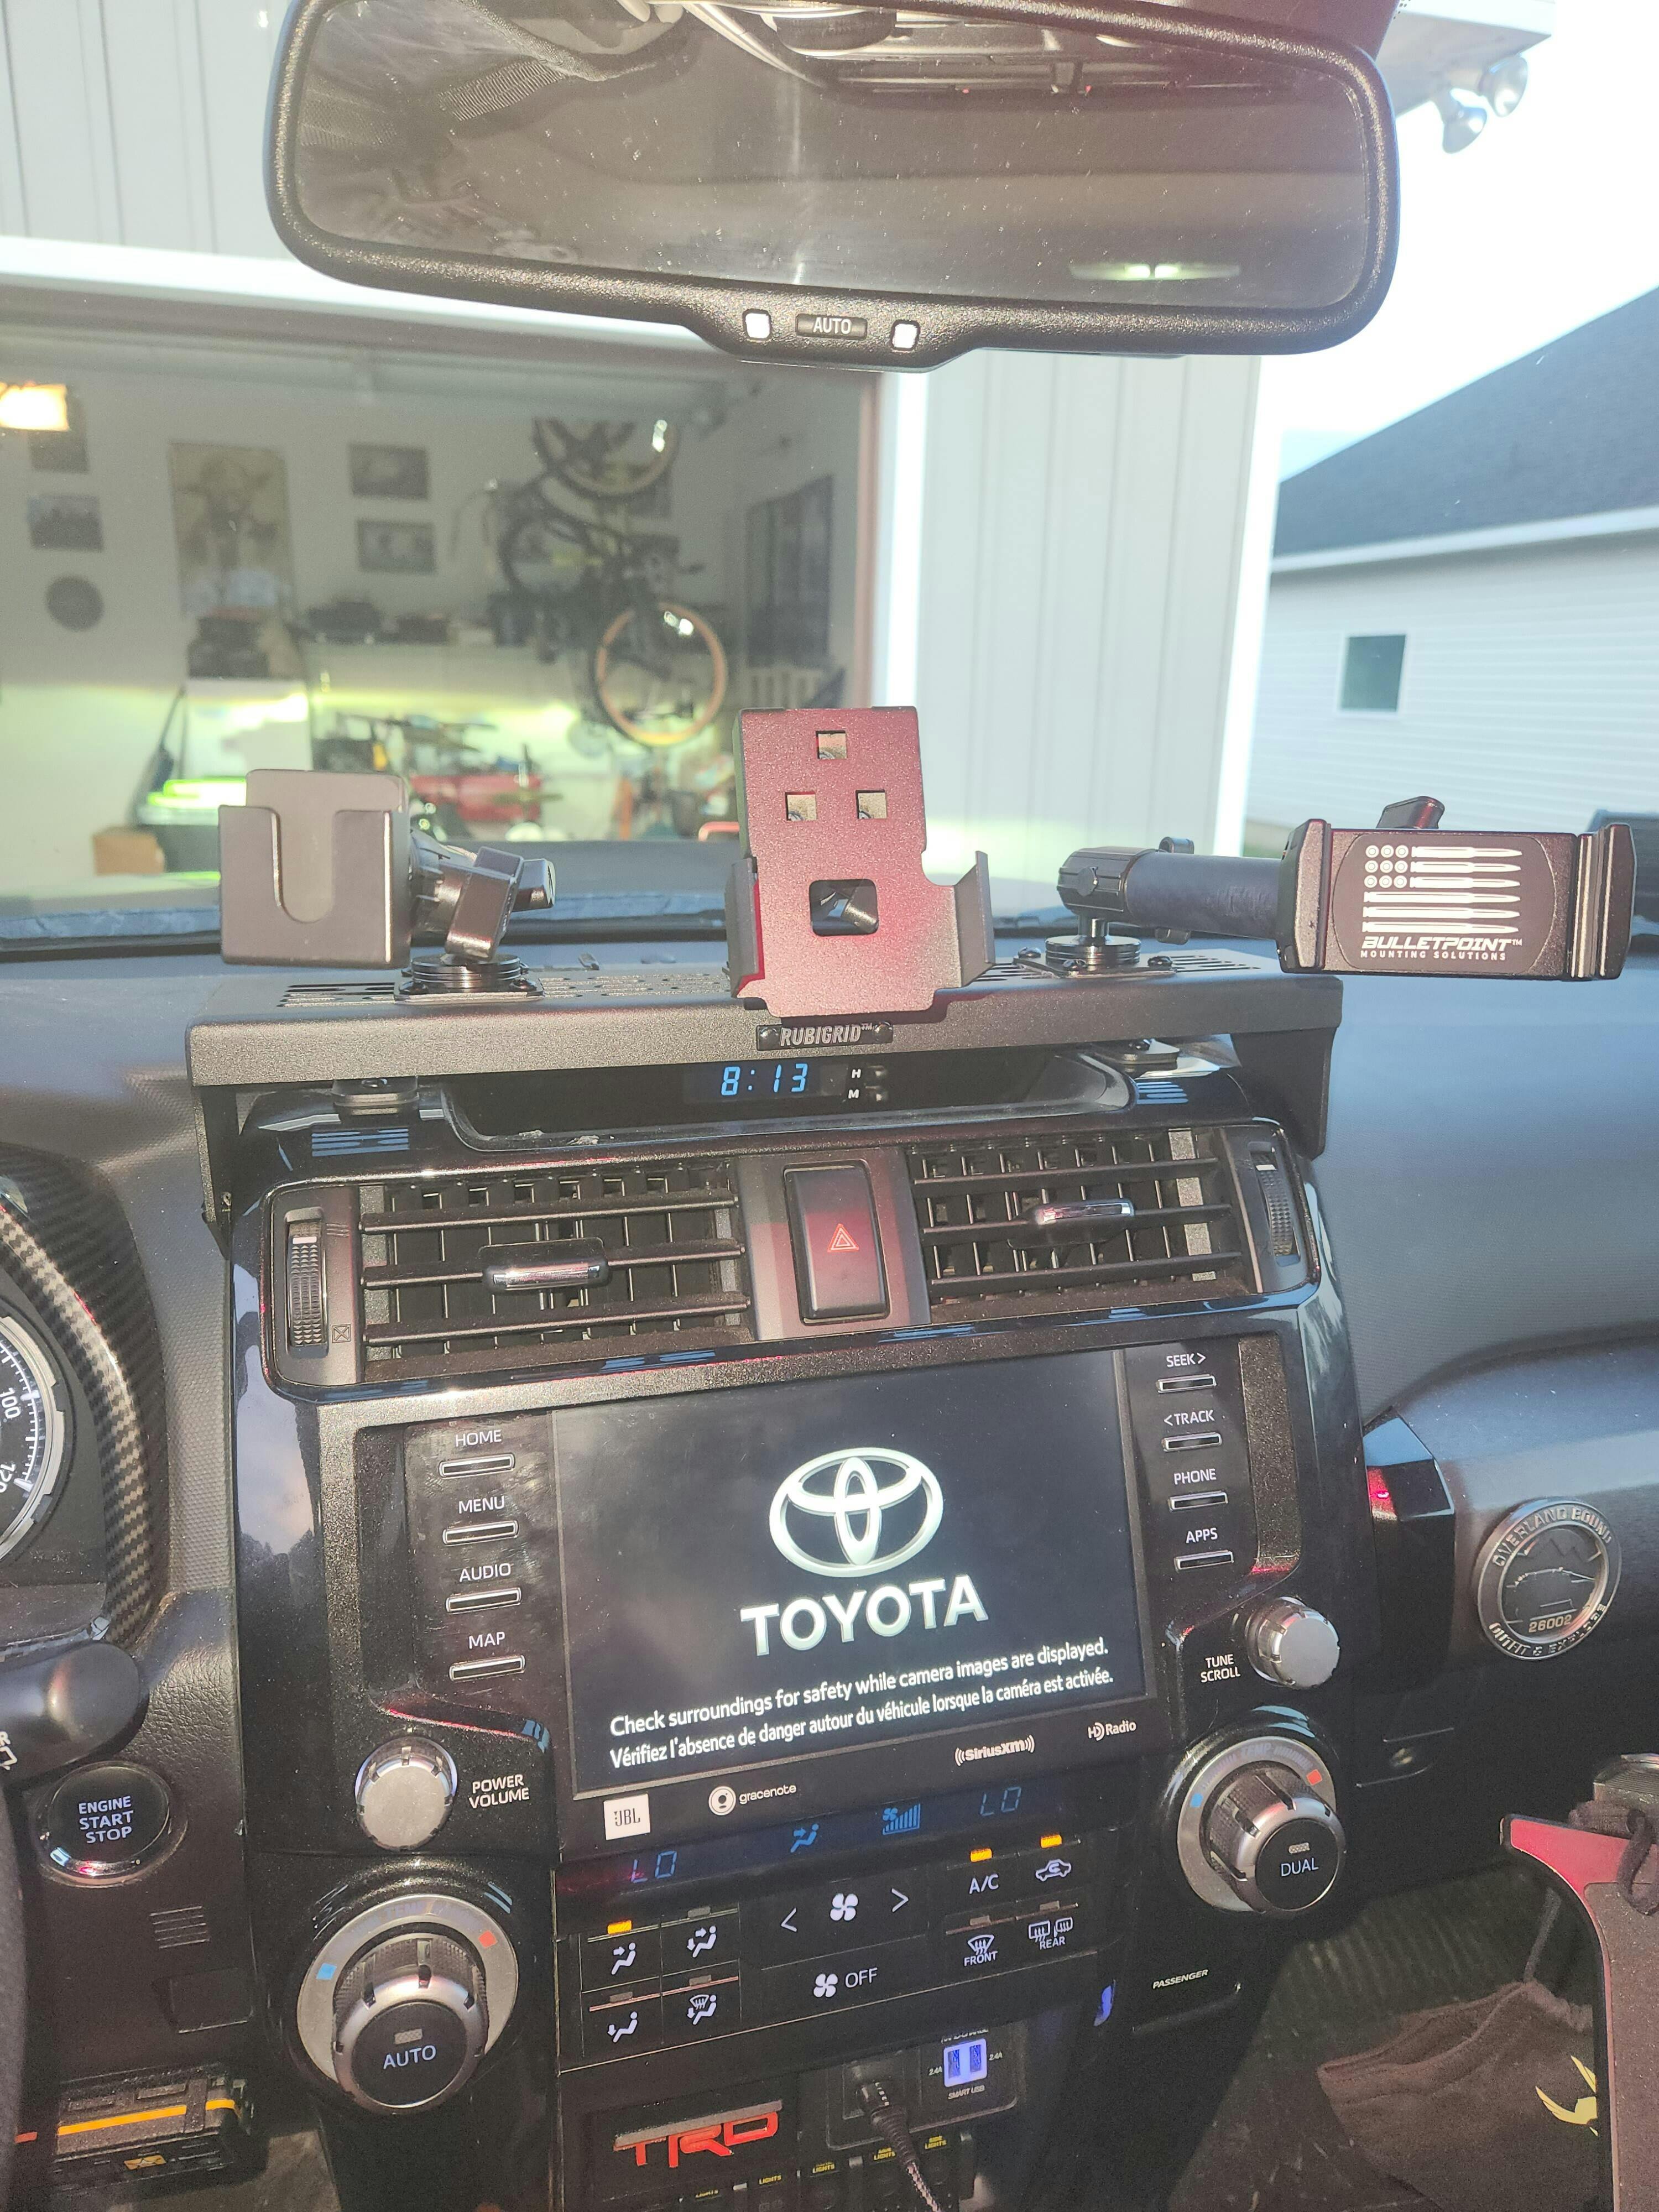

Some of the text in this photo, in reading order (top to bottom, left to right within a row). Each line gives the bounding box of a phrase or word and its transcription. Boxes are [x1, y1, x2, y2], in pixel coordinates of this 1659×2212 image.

[813, 316, 852, 335] AUTO
[1360, 950, 1506, 961] MOUNTING SOLUTIONS
[721, 1063, 808, 1095] 8:13
[851, 1068, 862, 1078] H
[848, 1089, 860, 1099] M
[1166, 1353, 1195, 1368] SEEK
[0, 1387, 21, 1419] 100
[1173, 1410, 1215, 1426] TRACK
[455, 1430, 502, 1447] HOME
[1173, 1468, 1217, 1485] PHONE
[458, 1495, 505, 1514] MENU
[1186, 1527, 1218, 1543] APPS
[1493, 1506, 1567, 1567] OVERLAND
[459, 1562, 512, 1582] AUDIO
[740, 1574, 989, 1656] TOYOTA
[1528, 1614, 1572, 1632] 26002
[468, 1631, 505, 1649] MAP
[1205, 1653, 1234, 1668] TUNE
[1200, 1665, 1240, 1683] SCROLL
[611, 1637, 1108, 1736] Check surroundings for safety while camera images are displayed.
[610, 1667, 1114, 1768] Vérifiez l'absence de danger autour du véhicule lorsque la caméra est activée.
[1105, 1720, 1136, 1735] Radio
[472, 1774, 524, 1794] POWER
[469, 1787, 530, 1809] VOLUME
[739, 1783, 797, 1805] gracenote
[79, 1796, 132, 1814] ENGINE
[79, 1810, 134, 1831] START
[614, 1808, 640, 1827] JBL
[85, 1826, 133, 1844] STOP
[1281, 1858, 1319, 1877] DUAL
[969, 1874, 999, 1894] A/C
[1039, 1936, 1066, 1950] REAR
[964, 1950, 998, 1966] FRONT
[845, 1967, 878, 1988] OFF
[1152, 1969, 1209, 1989] PASSENGER
[383, 2044, 437, 2069] AUTO
[947, 2085, 985, 2100] SMART USB
[613, 2100, 782, 2168] TRD
